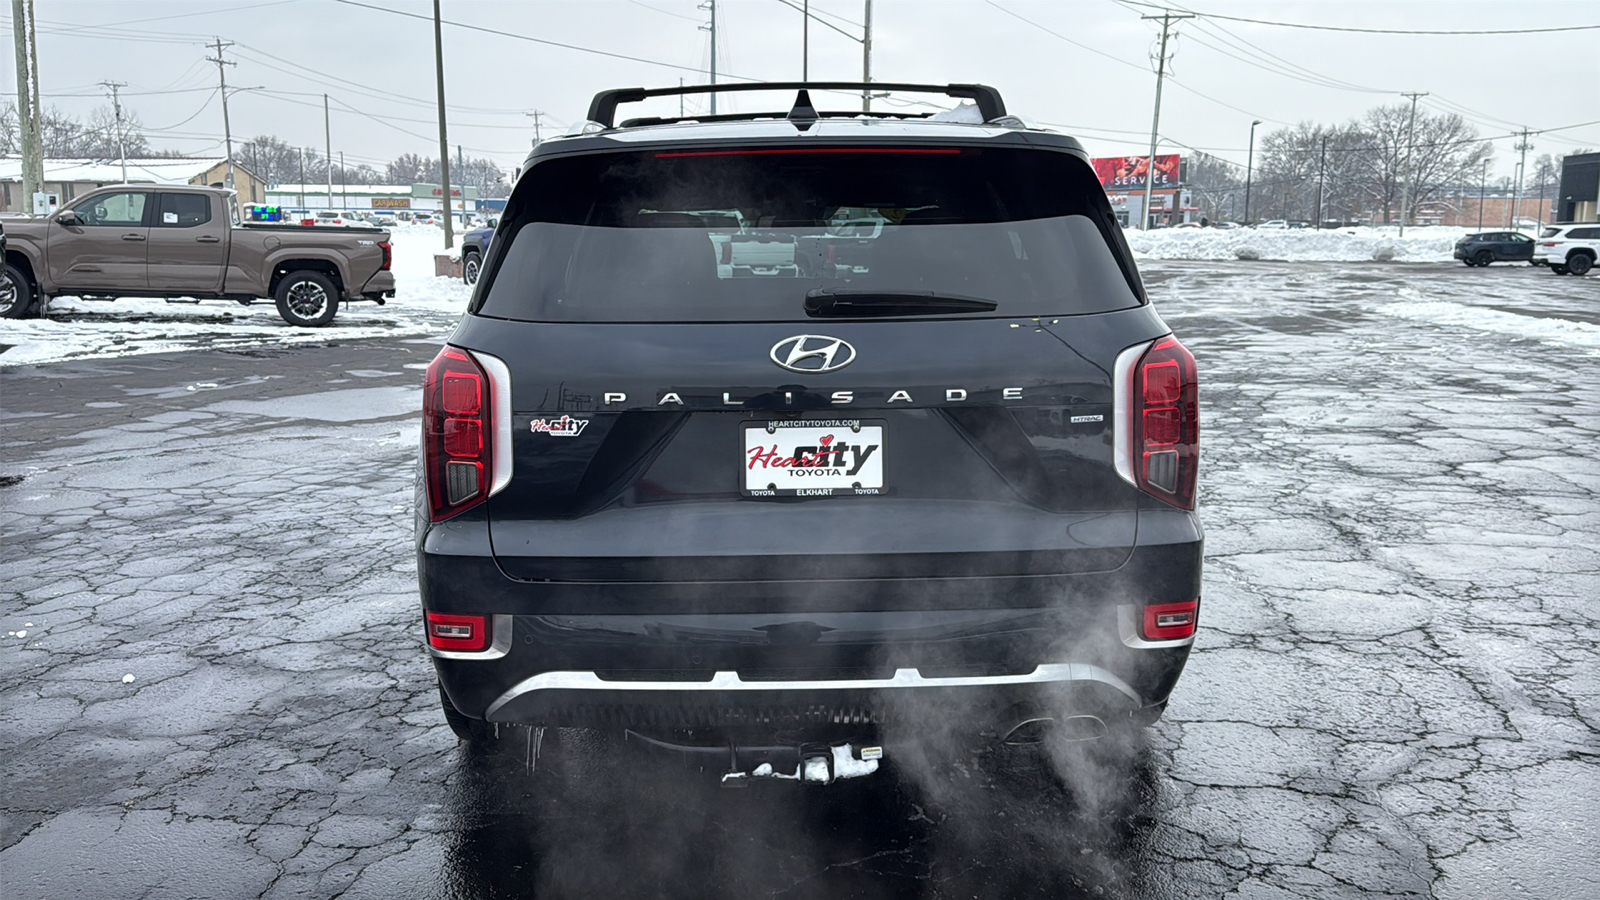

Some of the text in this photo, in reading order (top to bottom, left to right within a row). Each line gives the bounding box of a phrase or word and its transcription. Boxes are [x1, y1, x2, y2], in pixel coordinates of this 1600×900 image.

[1114, 174, 1168, 185] SERVCE
[373, 200, 408, 208] CAR WASH
[604, 387, 1024, 406] PALISADE
[768, 420, 860, 428] HEARTCITYTOYOTA.COM
[747, 434, 879, 476] Heart city
[787, 469, 841, 477] TOYOTA
[796, 488, 833, 496] ELKHART
